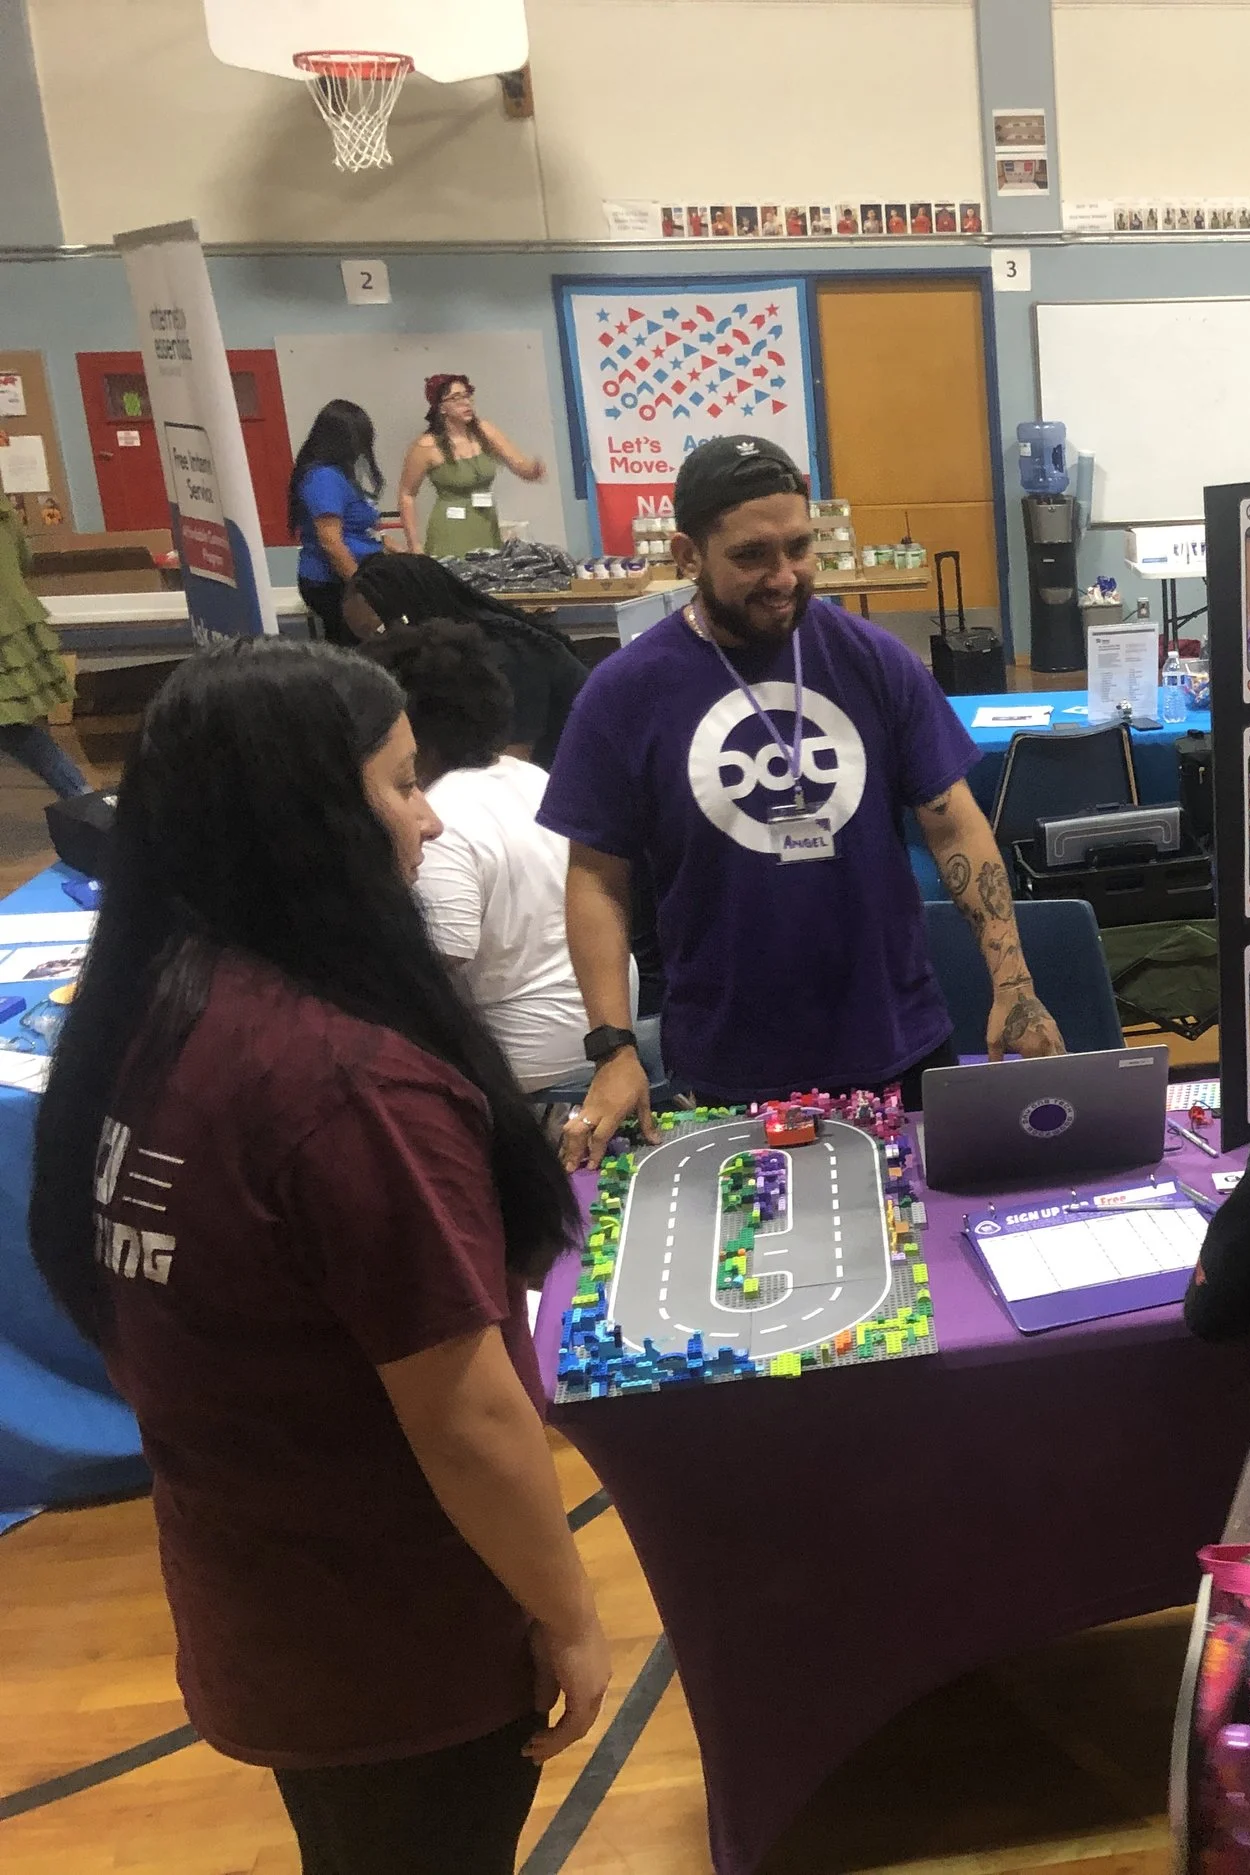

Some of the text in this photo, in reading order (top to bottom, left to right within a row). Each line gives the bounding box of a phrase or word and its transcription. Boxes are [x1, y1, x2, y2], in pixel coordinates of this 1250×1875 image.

[1006, 260, 1017, 278] 3
[360, 271, 374, 290] 2
[607, 436, 662, 454] Let's
[610, 457, 668, 474] Move
[783, 835, 829, 850] ANGEL
[1005, 1209, 1040, 1226] SIGN
[1041, 1205, 1061, 1220] UP
[1099, 1194, 1126, 1207] Free
